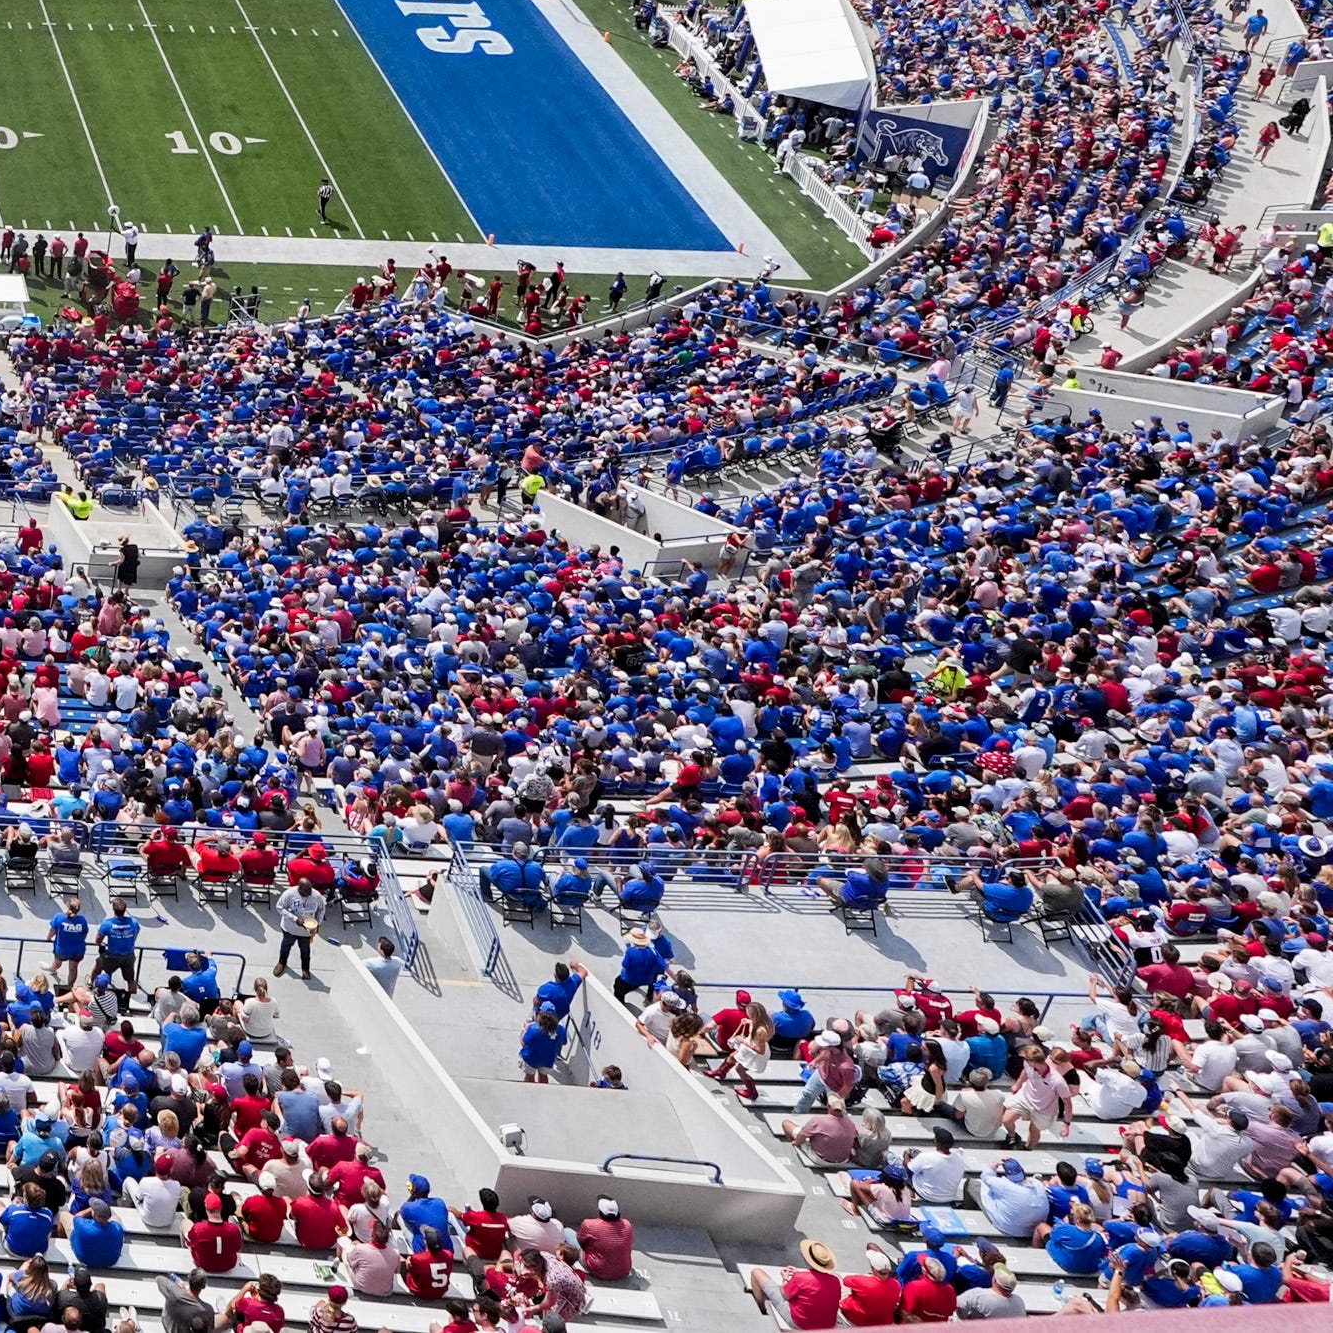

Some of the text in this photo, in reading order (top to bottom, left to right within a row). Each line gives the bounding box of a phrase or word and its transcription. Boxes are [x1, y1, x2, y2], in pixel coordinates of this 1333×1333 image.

[165, 130, 243, 155] 10
[62, 922, 84, 933] TAG
[429, 1263, 449, 1287] 5
